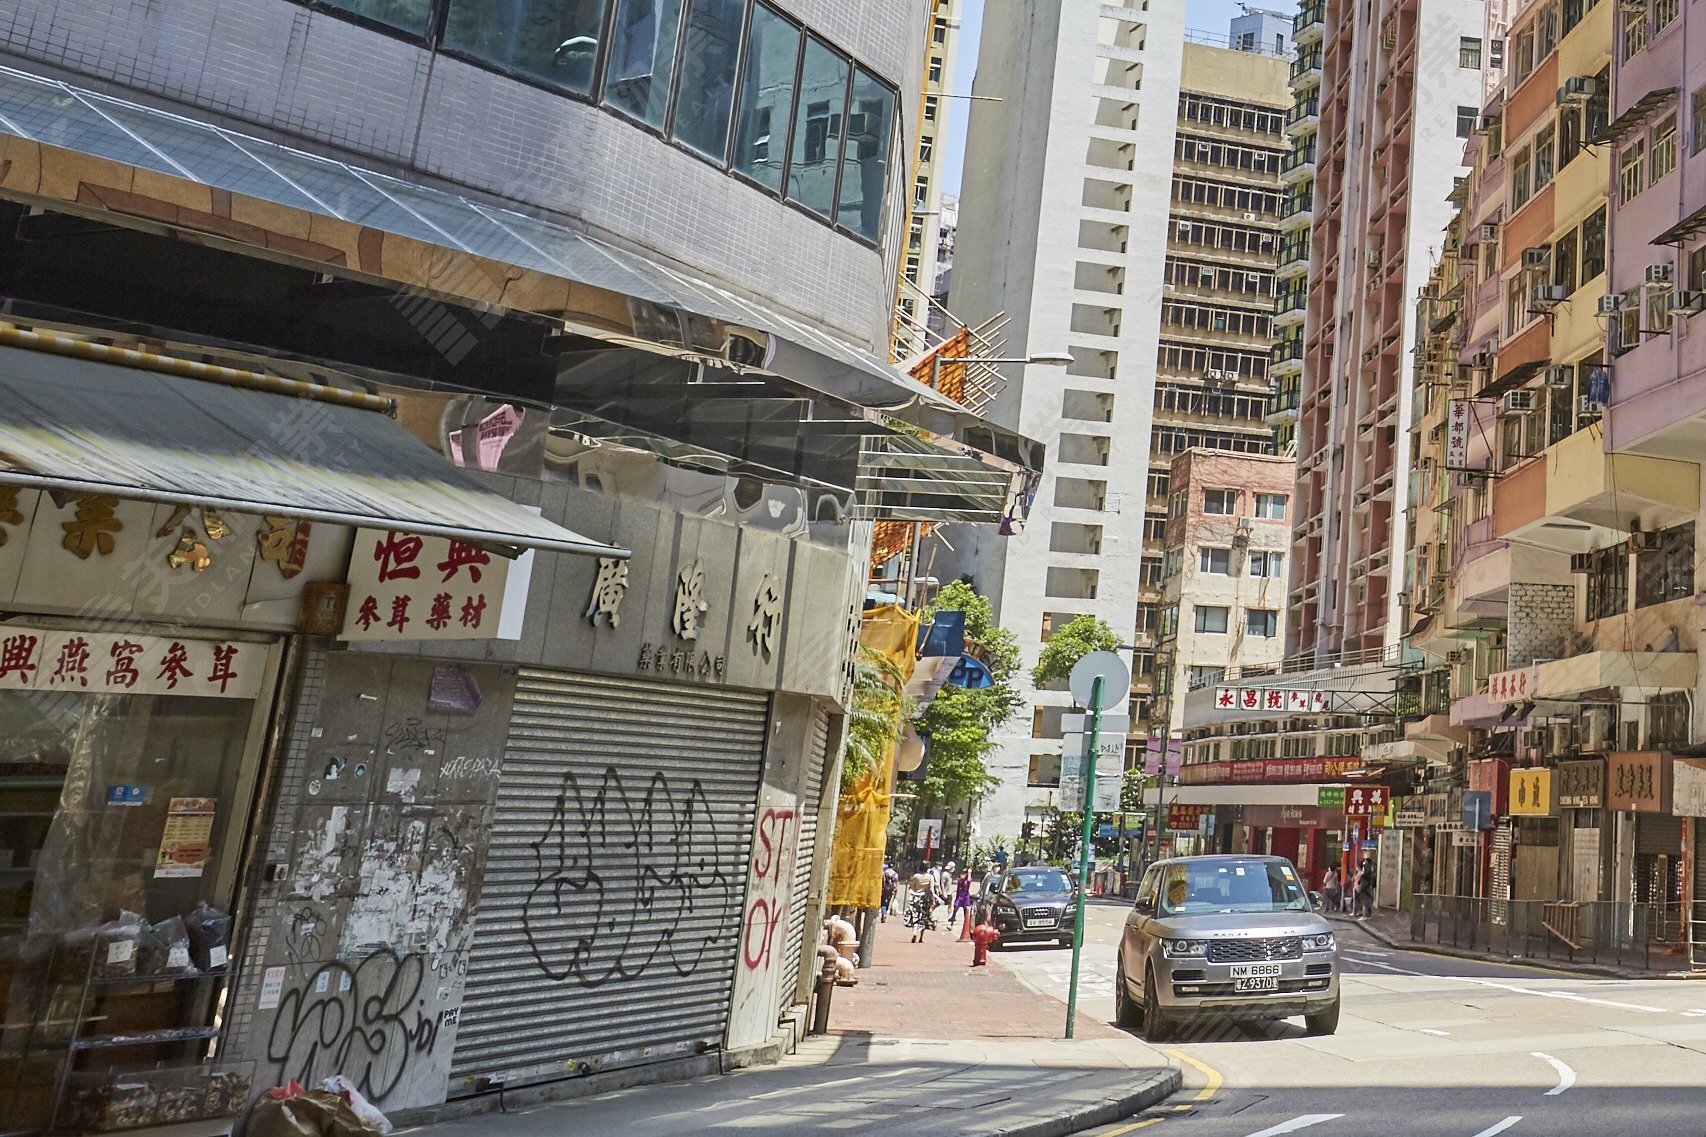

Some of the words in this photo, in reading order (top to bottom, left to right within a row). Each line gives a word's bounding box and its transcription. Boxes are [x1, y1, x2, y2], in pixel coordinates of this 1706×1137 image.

[586, 542, 782, 654] 廣隆行
[355, 592, 487, 633] 參茸藥材
[1219, 688, 1282, 709] 永昌號
[1232, 967, 1247, 976] NM
[443, 1007, 459, 1018] PAY
[444, 1016, 458, 1027] ME
